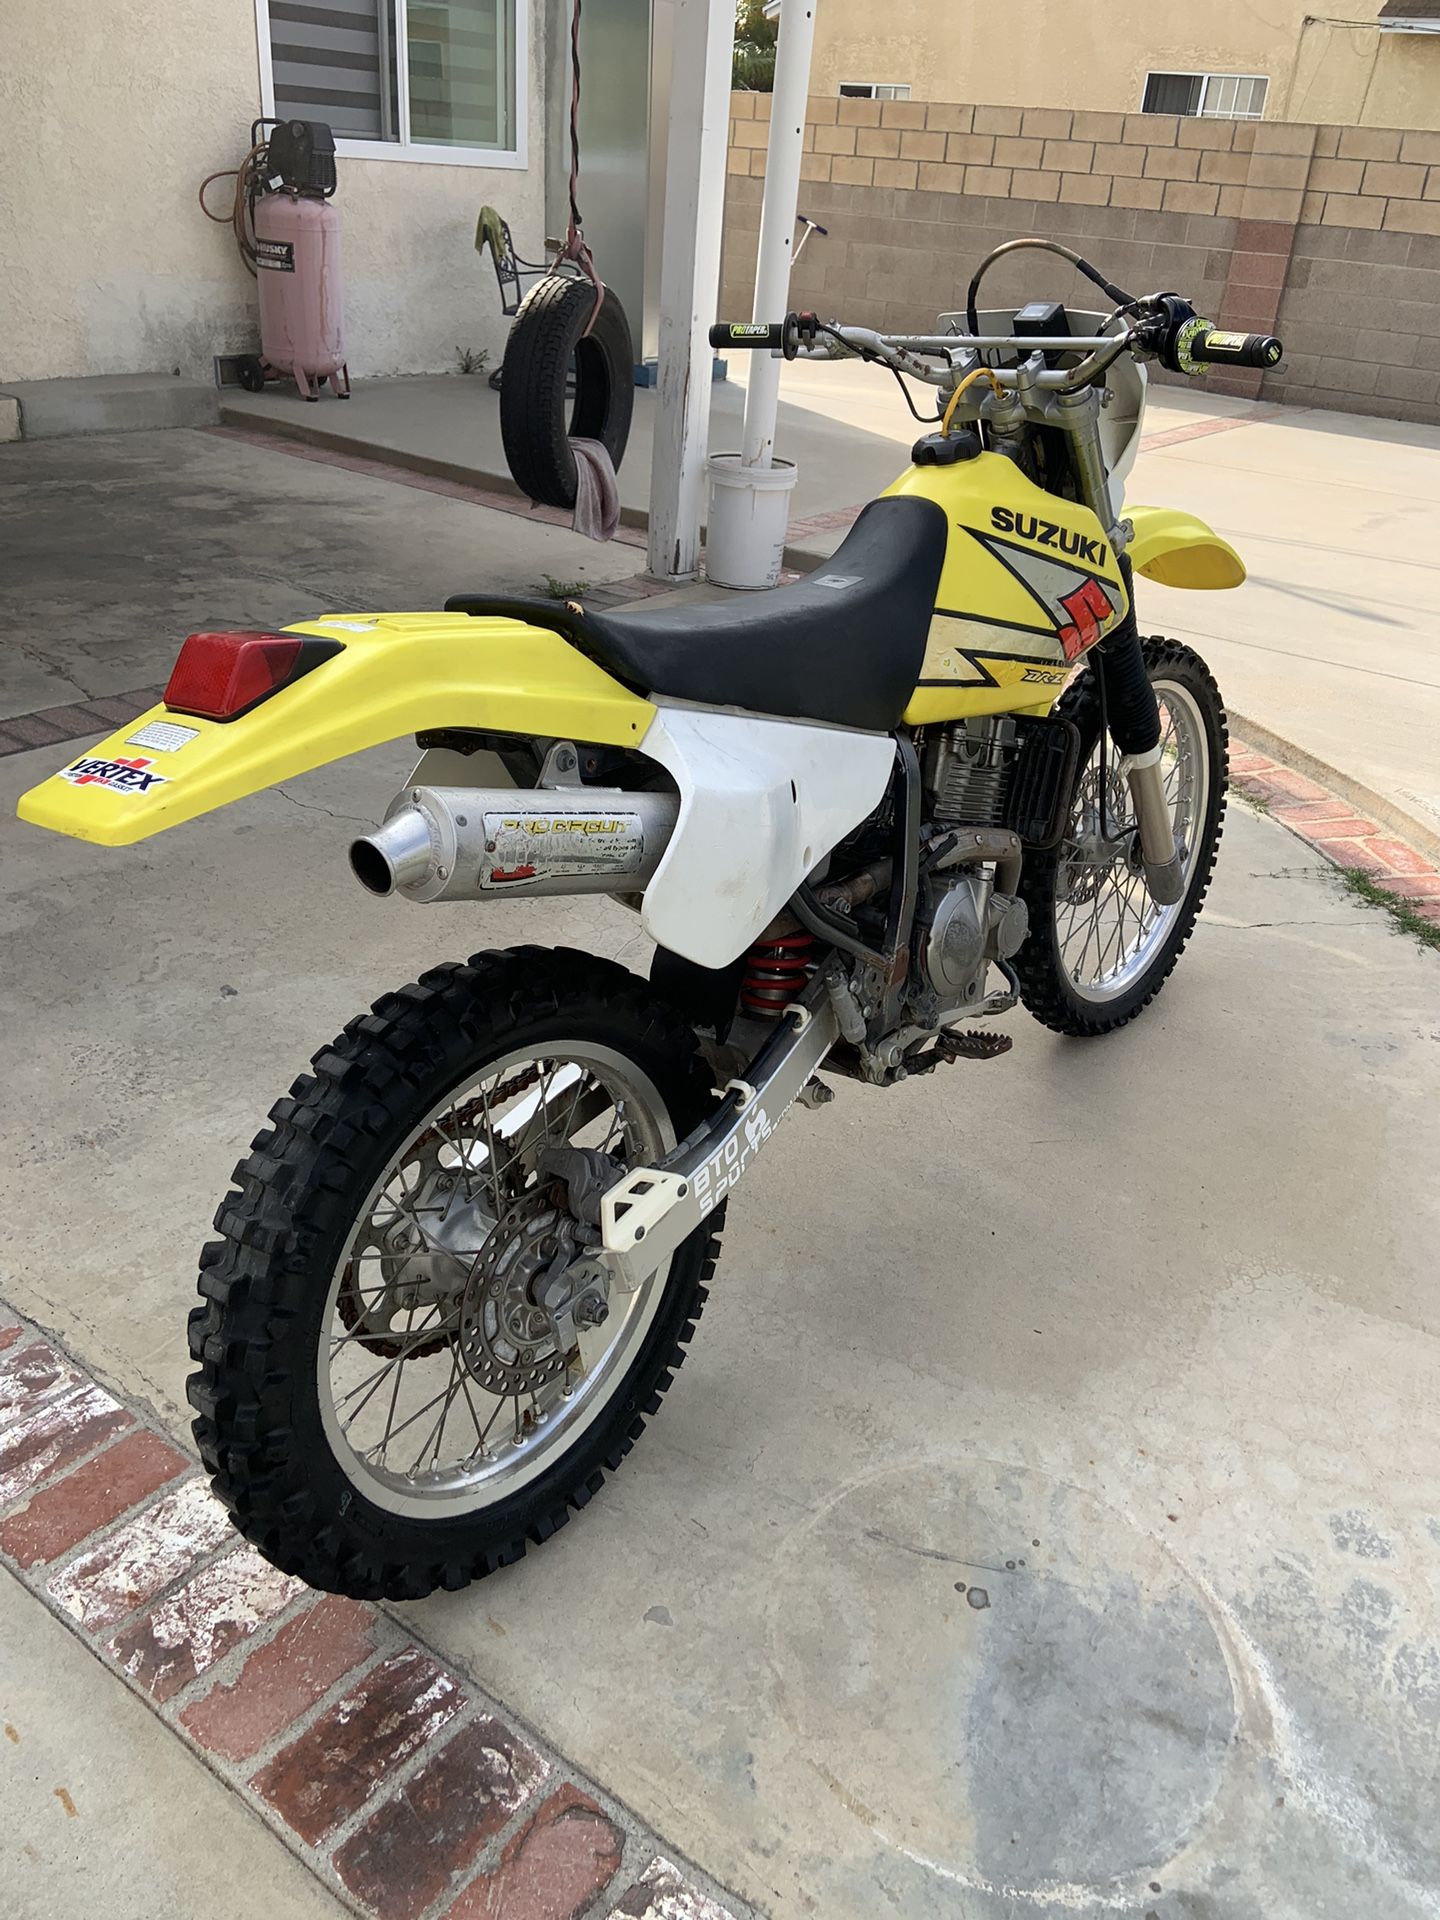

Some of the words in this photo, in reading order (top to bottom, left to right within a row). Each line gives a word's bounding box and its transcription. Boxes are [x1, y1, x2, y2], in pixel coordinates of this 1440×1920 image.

[990, 506, 1107, 567] SUZUKI
[1021, 668, 1066, 685] DR-Z
[69, 758, 167, 791] VERTEX
[552, 819, 631, 836] CIRCUIT
[693, 1134, 738, 1198] BTO
